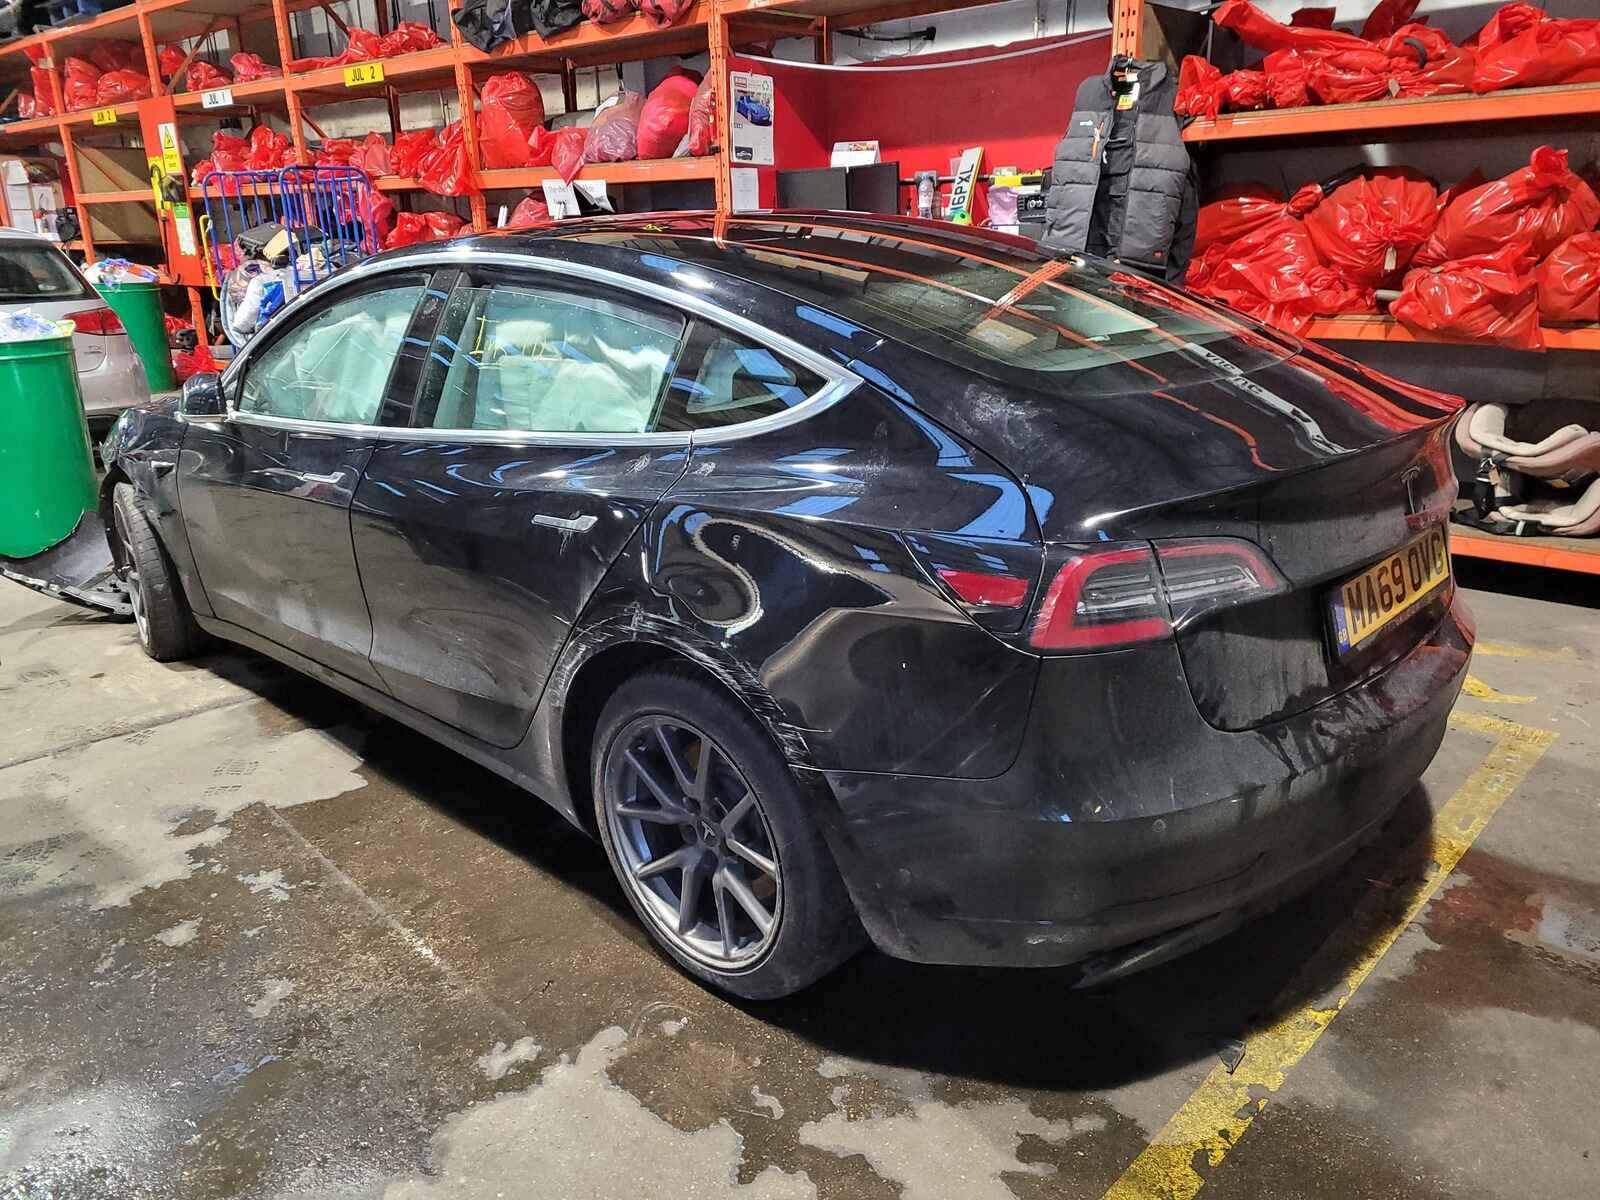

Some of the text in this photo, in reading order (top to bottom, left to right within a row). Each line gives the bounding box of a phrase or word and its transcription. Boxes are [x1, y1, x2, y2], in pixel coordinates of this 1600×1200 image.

[352, 65, 376, 82] JUL 2
[1347, 557, 1406, 635] MA69
